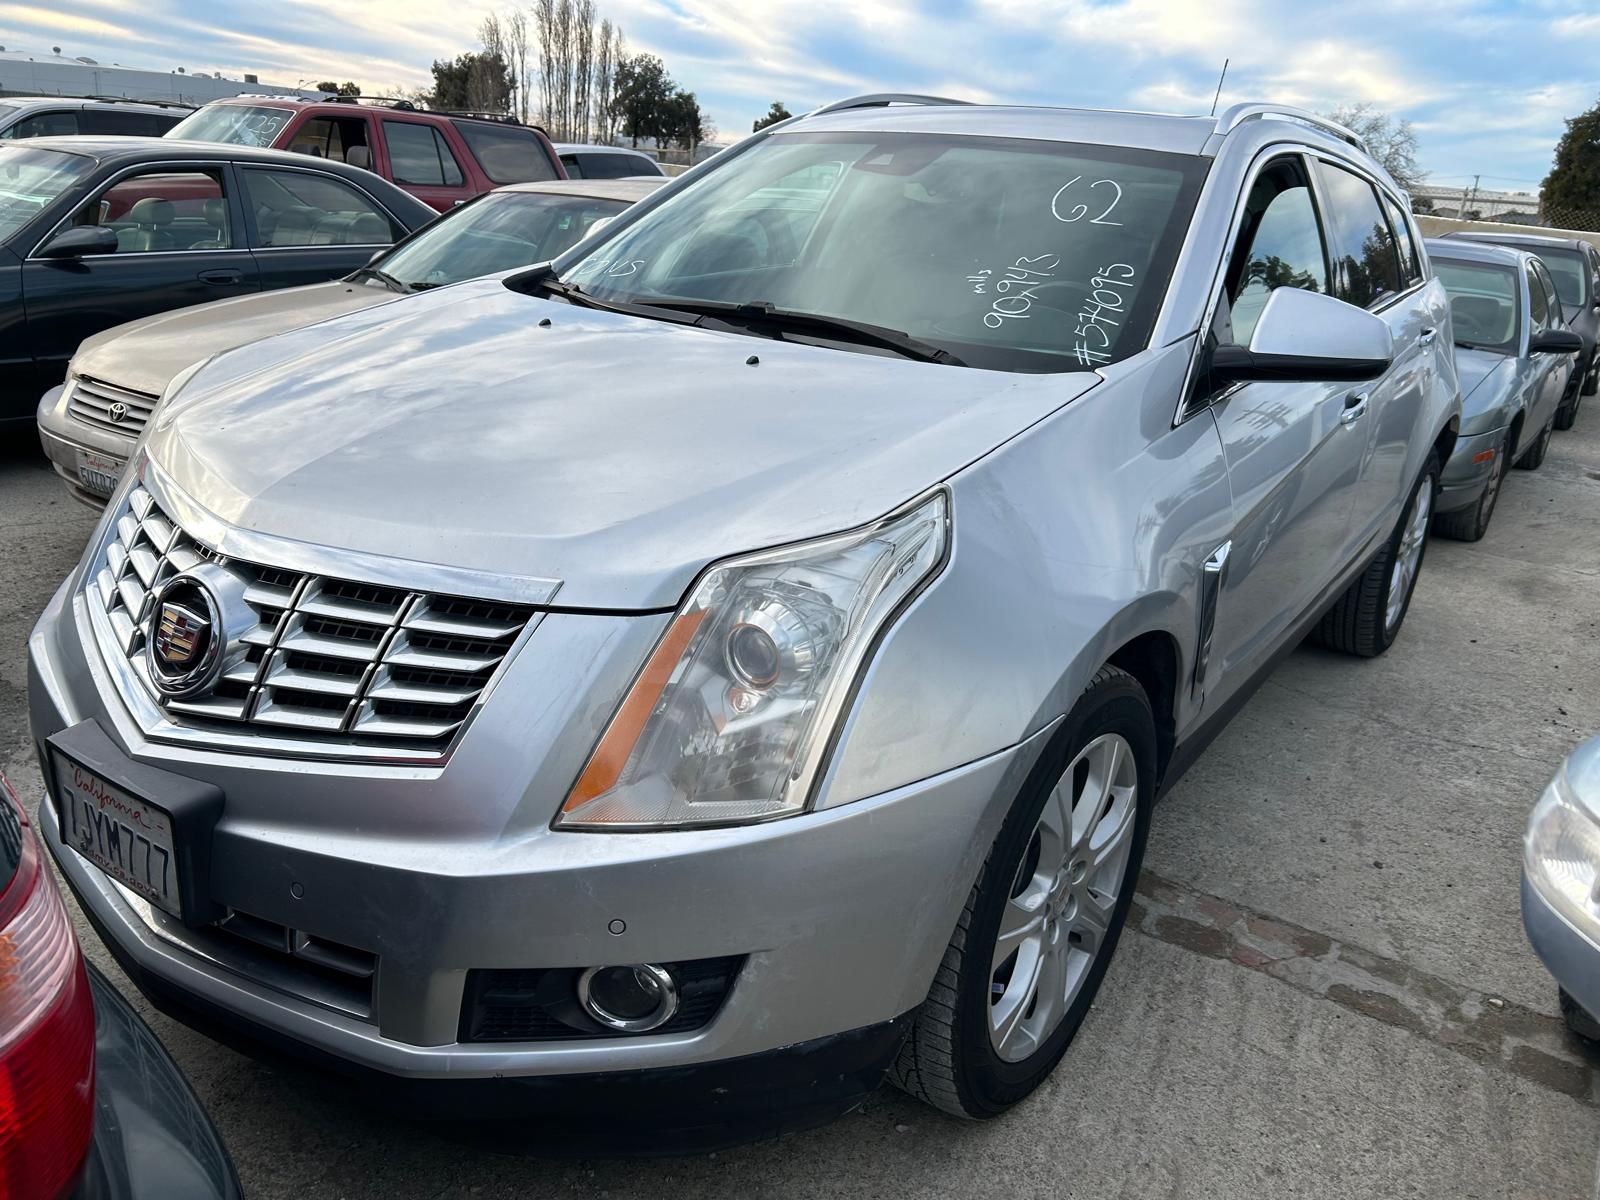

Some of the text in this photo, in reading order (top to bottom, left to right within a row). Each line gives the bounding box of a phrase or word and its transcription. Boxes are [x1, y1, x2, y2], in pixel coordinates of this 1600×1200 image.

[1051, 175, 1123, 226] 62
[1073, 263, 1135, 366] #574095
[73, 767, 156, 831] California
[63, 786, 169, 898] 7JYM777
